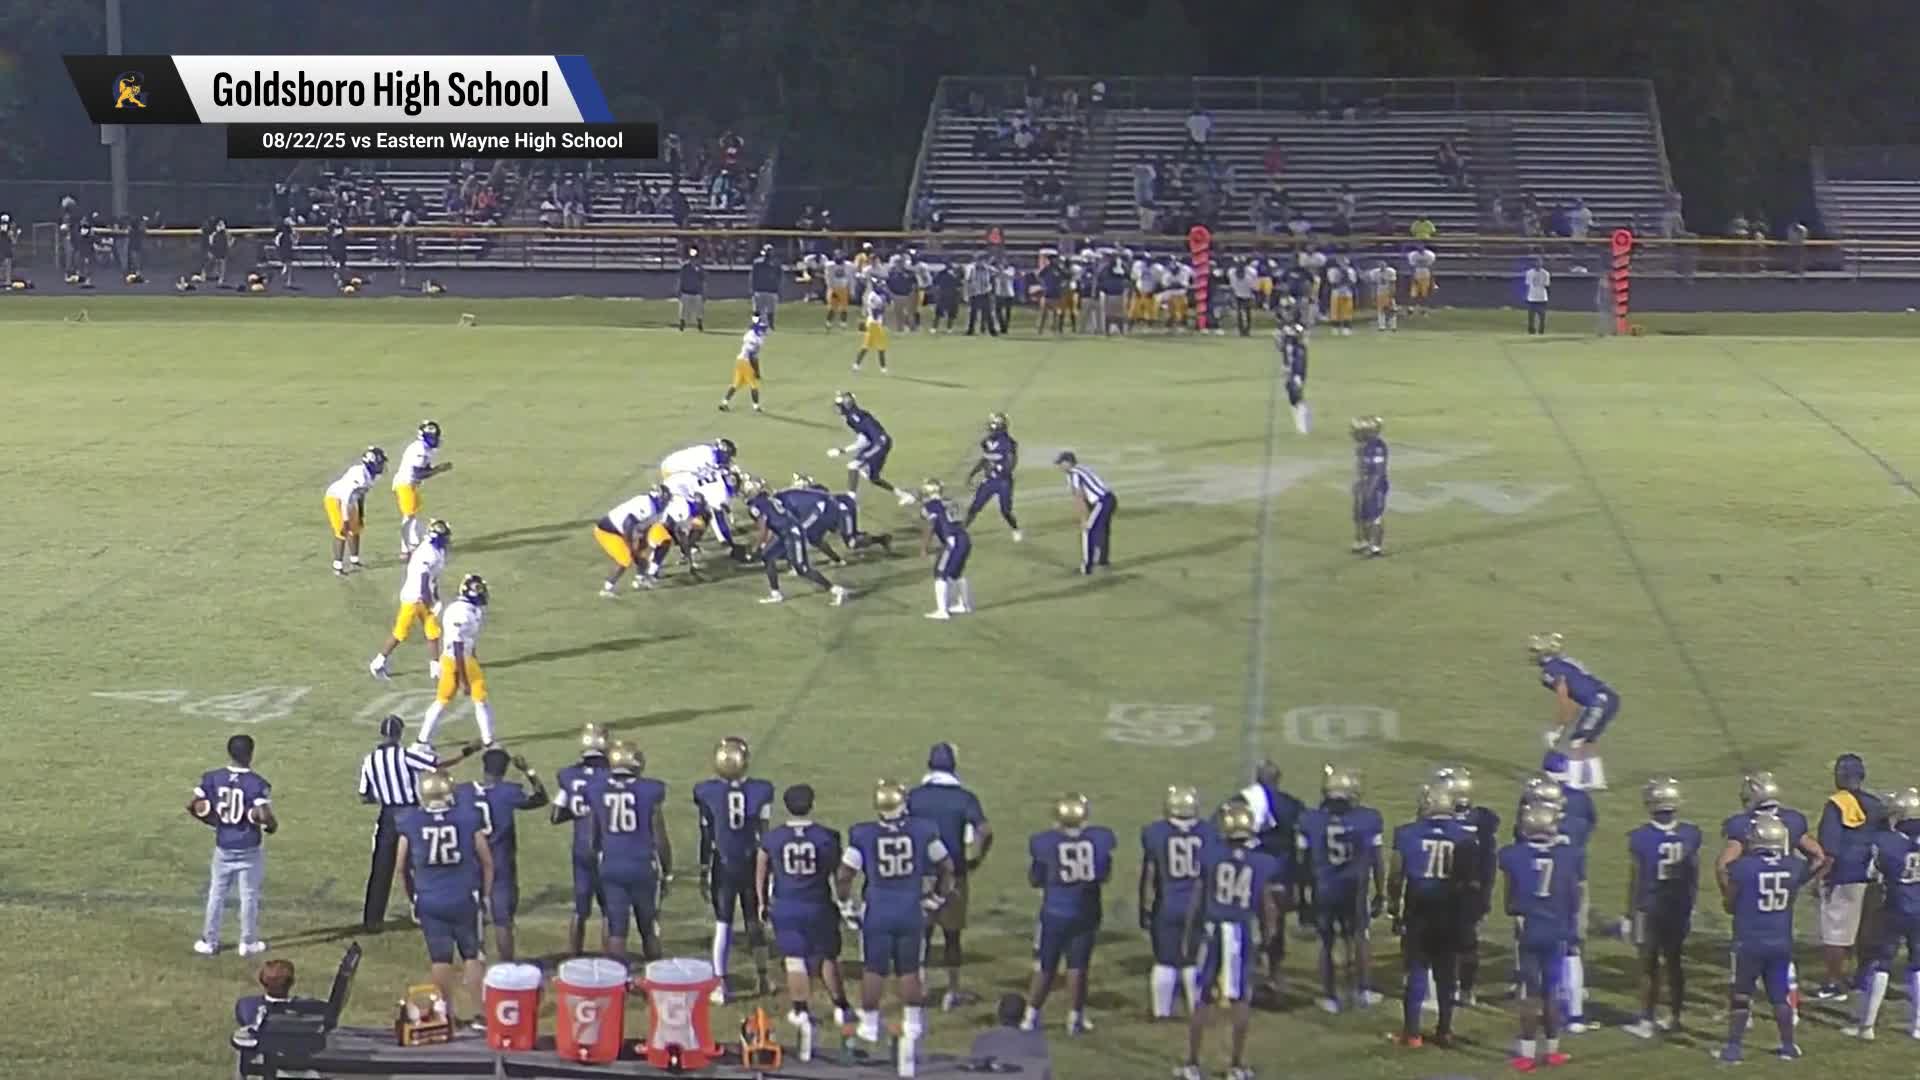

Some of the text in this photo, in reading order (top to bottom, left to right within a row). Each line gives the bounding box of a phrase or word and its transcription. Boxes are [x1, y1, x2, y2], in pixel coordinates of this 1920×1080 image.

[216, 786, 244, 824] 20
[603, 791, 637, 833] 76
[728, 790, 745, 831] 8
[422, 825, 461, 865] 72
[878, 836, 914, 878] 52
[1059, 839, 1095, 882] 58
[1421, 837, 1455, 879] 70
[1215, 861, 1253, 908] 84
[1533, 856, 1555, 897] 7
[1758, 870, 1792, 913] 55
[495, 1000, 520, 1026] G
[575, 999, 598, 1023] G
